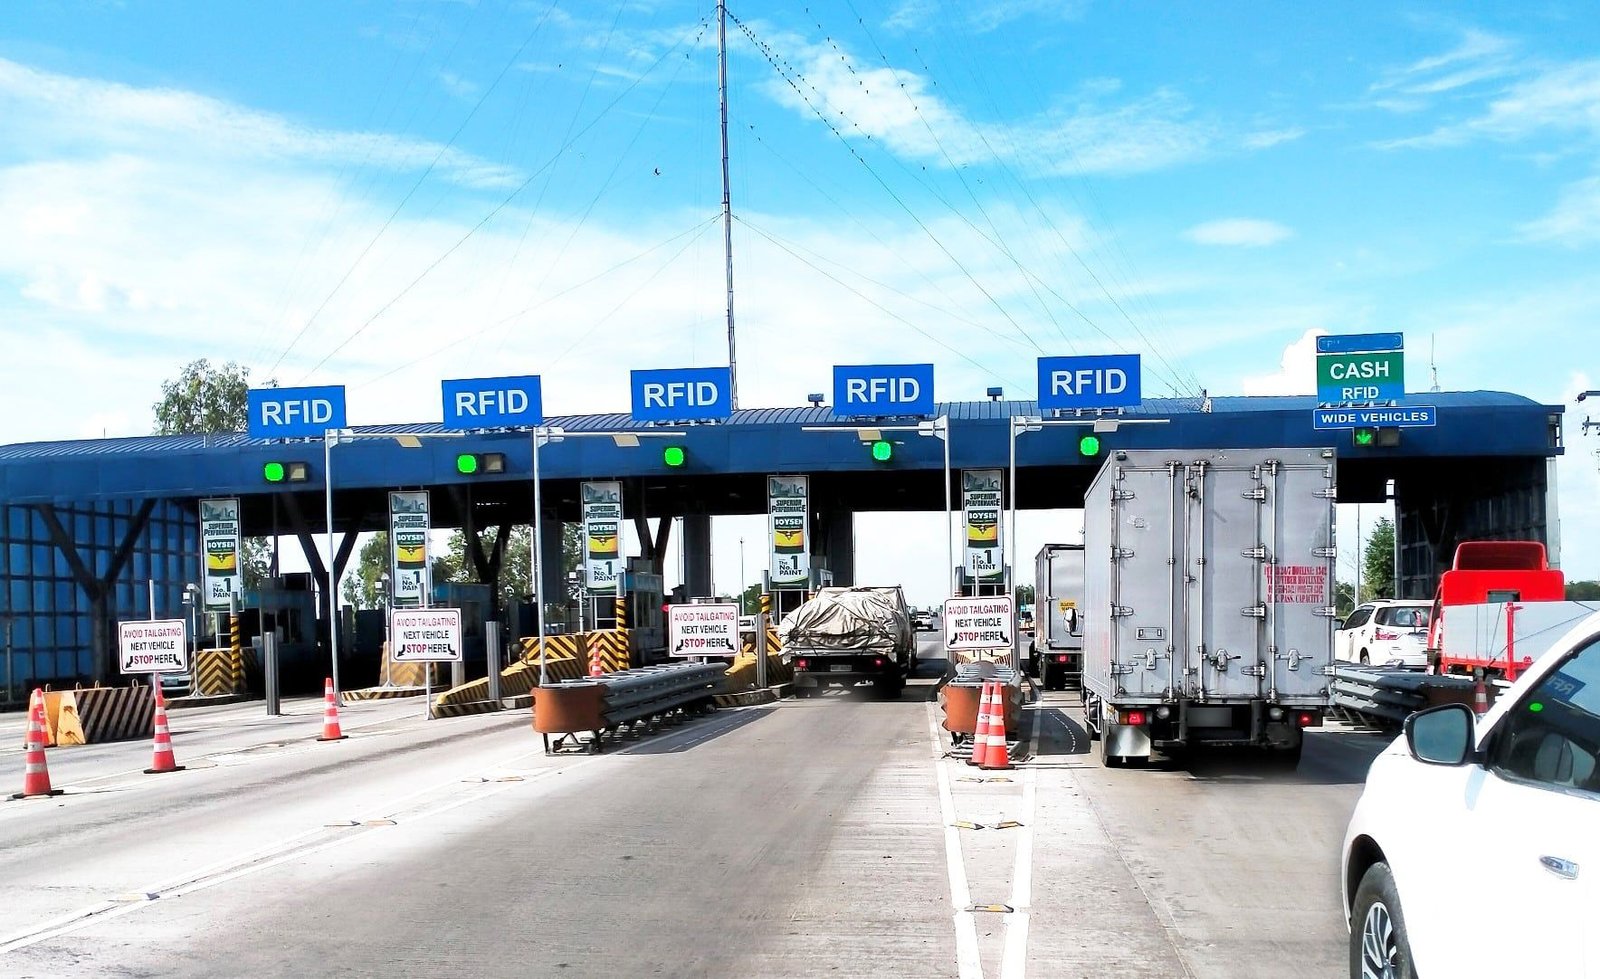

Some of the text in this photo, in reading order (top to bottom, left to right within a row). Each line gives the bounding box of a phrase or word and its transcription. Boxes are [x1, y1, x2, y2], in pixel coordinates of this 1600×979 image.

[1330, 361, 1389, 379] CASH
[1050, 369, 1127, 395] RFID
[643, 382, 719, 407] RFID
[847, 377, 920, 403] RFID
[1342, 386, 1379, 400] RFID
[455, 389, 528, 417] RFID
[261, 399, 333, 426] RFID
[1321, 412, 1428, 423] WIDE VEHICLES
[775, 518, 803, 526] BOYSEN
[791, 555, 799, 569] 1
[984, 550, 992, 564] 1
[605, 561, 612, 575] 1
[413, 570, 421, 584] 1
[223, 577, 232, 593] 1
[948, 605, 1008, 614] AVOID TAILGATING
[675, 612, 734, 621] AVOID TAILGATING
[418, 618, 456, 626] TAILGATING
[955, 618, 1001, 627] NEXT VEHICLE
[124, 628, 181, 638] AVOID TAILGATING
[404, 630, 449, 639] NEXT VEHICLE
[682, 625, 727, 634] NEXT VEHICLE
[959, 631, 999, 641] STOP HERE
[131, 641, 174, 650] NEXT VEHICLE
[685, 638, 725, 647] STOP HERE
[407, 644, 447, 653] STOP HERE
[134, 654, 173, 664] STOP HERE
